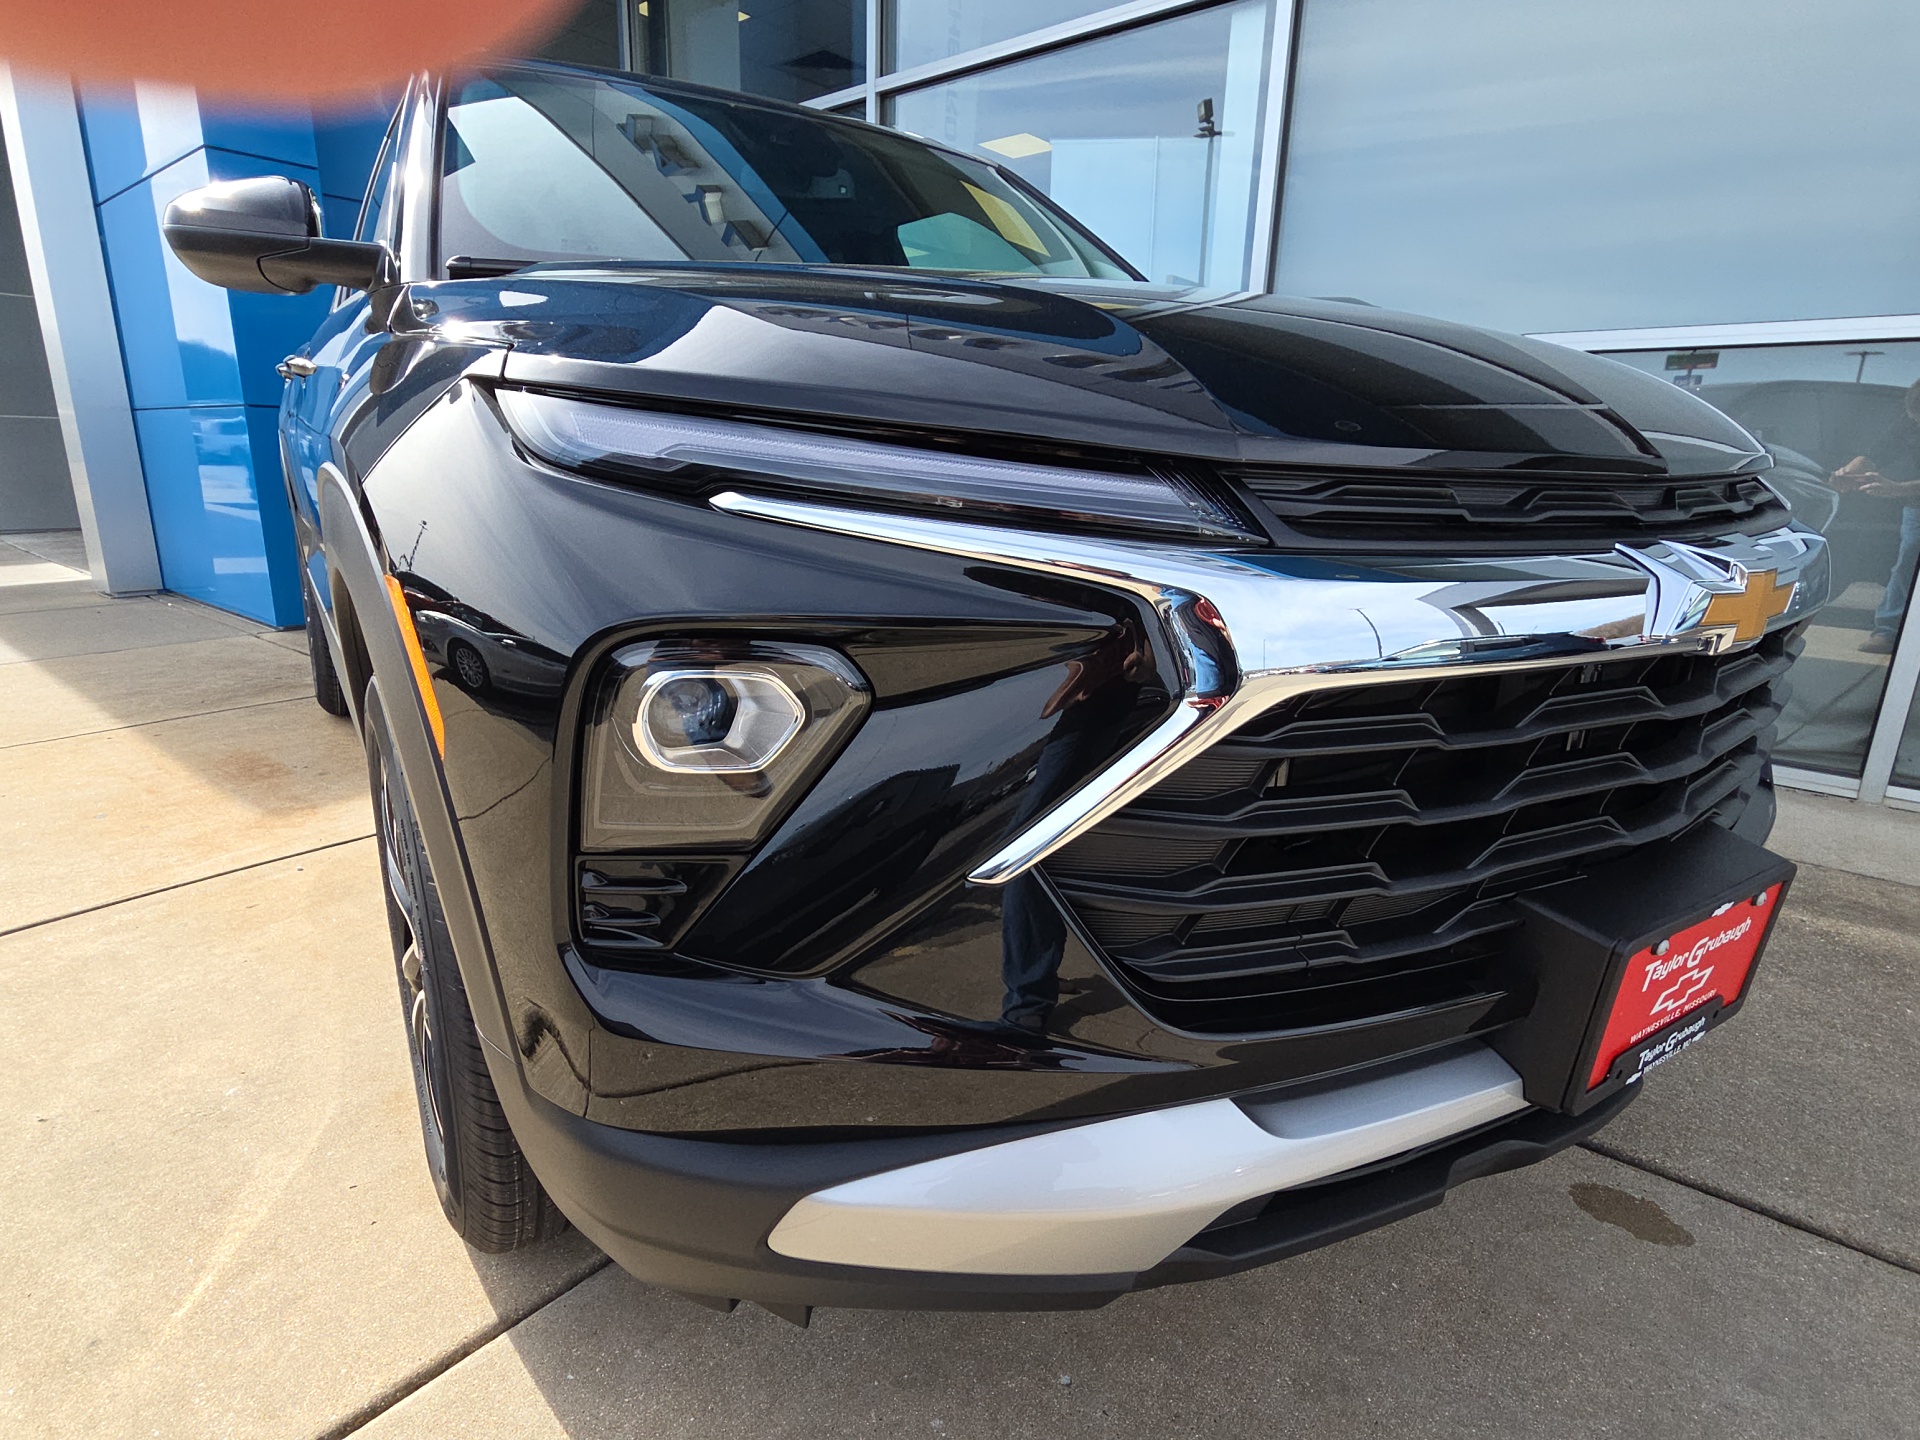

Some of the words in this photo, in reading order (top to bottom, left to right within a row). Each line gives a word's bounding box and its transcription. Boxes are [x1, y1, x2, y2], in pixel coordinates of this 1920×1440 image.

[1642, 952, 1689, 992] Taylor
[1686, 916, 1752, 969] Grubaugh
[1638, 1041, 1666, 1070] Taylor
[1664, 1016, 1706, 1052] Grubaugh
